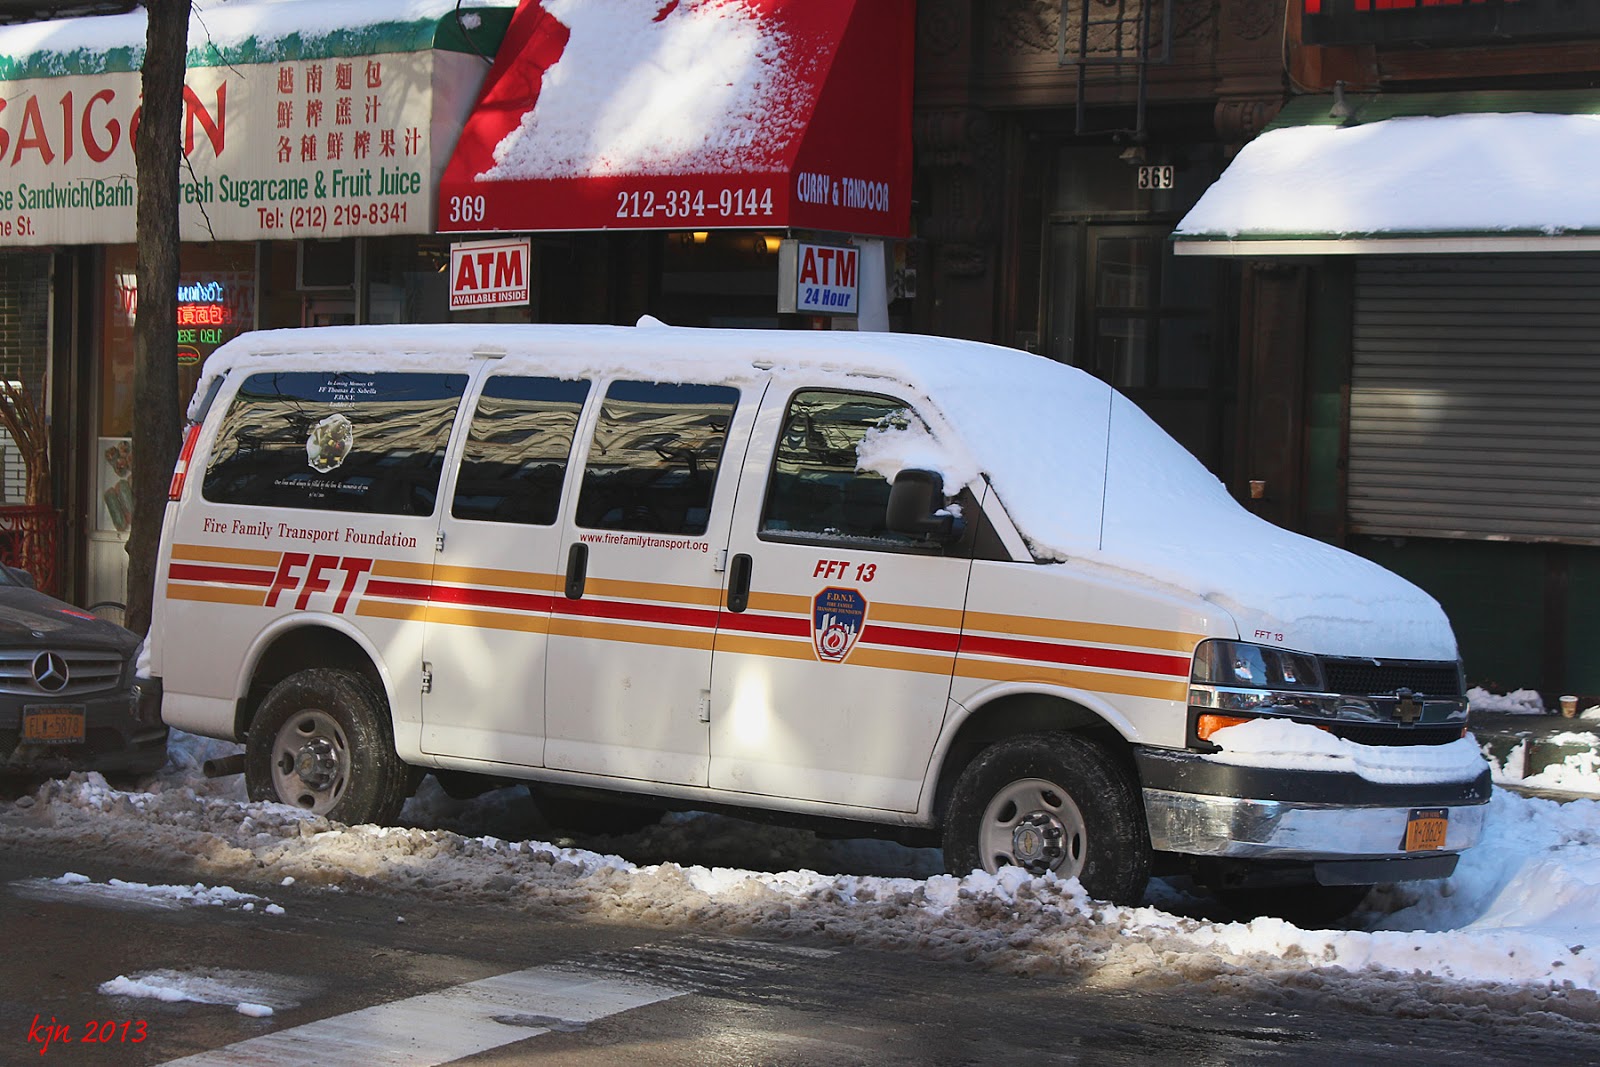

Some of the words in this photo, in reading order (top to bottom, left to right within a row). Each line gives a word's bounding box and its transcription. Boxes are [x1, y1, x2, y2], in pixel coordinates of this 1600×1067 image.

[0, 80, 227, 168] AIGN
[178, 175, 214, 205] resh
[219, 174, 309, 208] Sugarcane
[314, 169, 327, 199] &
[332, 168, 373, 198] Fruit
[377, 166, 421, 196] Juice
[1140, 167, 1172, 188] 369
[616, 187, 773, 219] 212-334-9144
[797, 172, 830, 203] CURRY
[832, 181, 839, 207] &
[842, 177, 889, 213] TANDOOR
[257, 207, 284, 229] Tel:
[290, 205, 327, 233] (212)
[333, 201, 408, 227] 219-8341
[449, 195, 486, 223] 369
[17, 216, 35, 236] St.
[455, 250, 523, 291] ATM
[799, 247, 856, 288] ATM
[453, 293, 497, 305] AVAILABLE
[498, 290, 526, 302] INSIDE
[804, 288, 820, 305] 24
[822, 289, 850, 307] Hour
[202, 518, 227, 534] Fire
[231, 519, 273, 540] Family
[278, 523, 340, 544] Transport
[344, 528, 417, 548] Foundation
[579, 532, 709, 553] www.firefamilytransport.org
[265, 552, 373, 614] FFT
[812, 559, 850, 581] FFT
[855, 562, 877, 582] 13
[826, 592, 855, 603] F.D.N.Y.
[1254, 629, 1271, 641] FFT
[1274, 632, 1284, 642] 13
